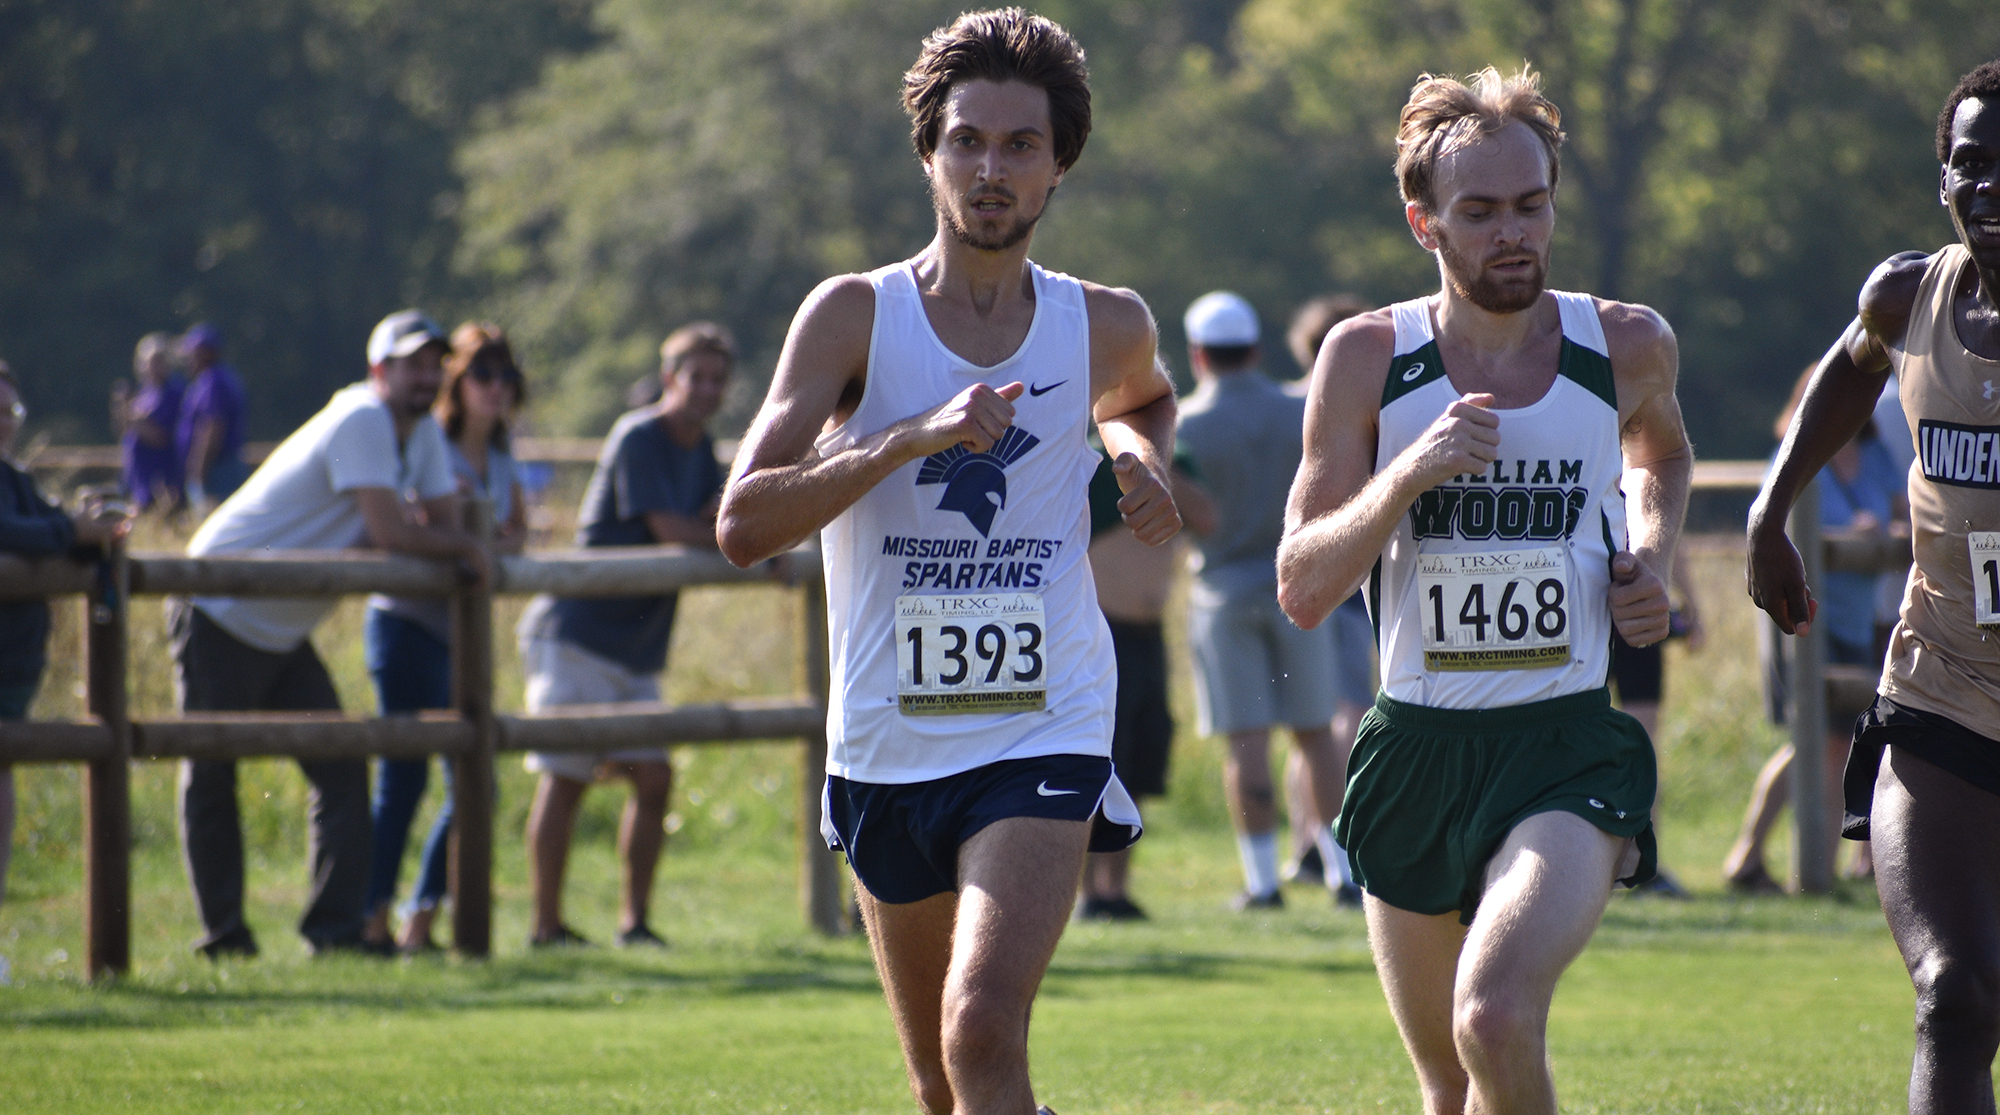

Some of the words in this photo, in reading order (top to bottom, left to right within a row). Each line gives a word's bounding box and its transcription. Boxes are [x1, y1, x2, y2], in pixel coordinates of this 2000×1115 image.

[1454, 459, 1583, 484] LLIAM
[882, 536, 978, 559] MISSOURI
[986, 538, 1063, 559] BAPTIST
[1455, 553, 1521, 568] TRXC
[902, 562, 1043, 589] SPARTANS
[936, 597, 999, 610] TRXC
[1428, 578, 1567, 642] 1468
[907, 622, 1043, 685] 1393
[1428, 646, 1567, 661] WWW.TRXCTIMING.COM
[903, 691, 1042, 704] WWW.TRXCTIMING.COM
